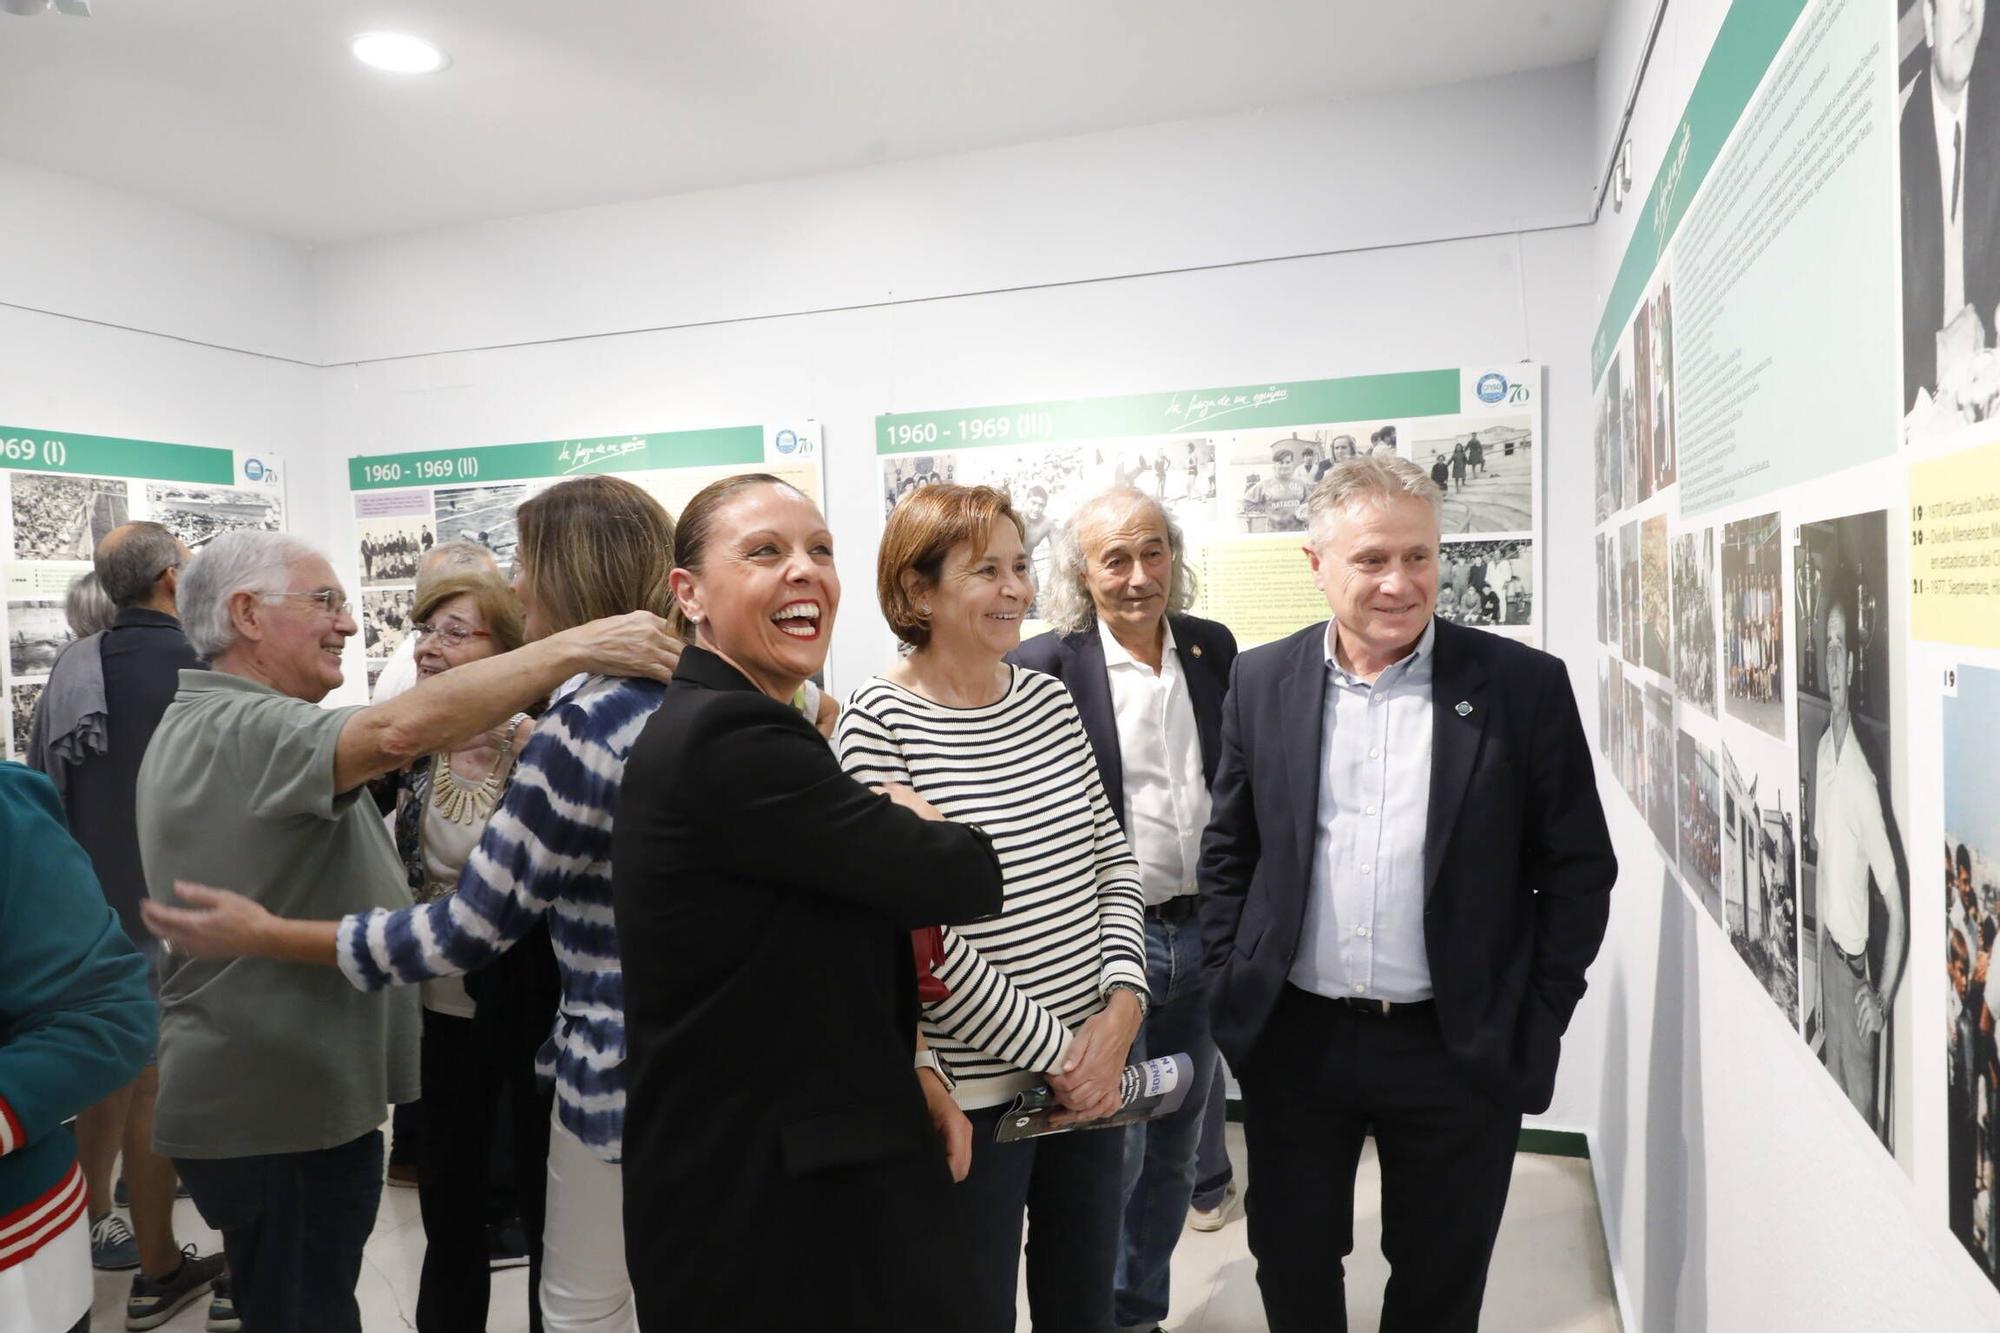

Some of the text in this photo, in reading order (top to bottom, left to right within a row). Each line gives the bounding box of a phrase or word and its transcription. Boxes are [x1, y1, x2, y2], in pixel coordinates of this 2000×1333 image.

[1509, 383, 1530, 403] 70
[887, 423, 937, 445] 1960
[958, 417, 1010, 440] 1969
[43, 440, 66, 466] (I)
[364, 463, 401, 482] 1960
[415, 459, 453, 479] 1969
[458, 456, 479, 478] (II)
[1913, 505, 1923, 521] 19
[1912, 529, 1924, 545] 20
[1912, 578, 1924, 594] 21
[1943, 669, 1956, 687] 19
